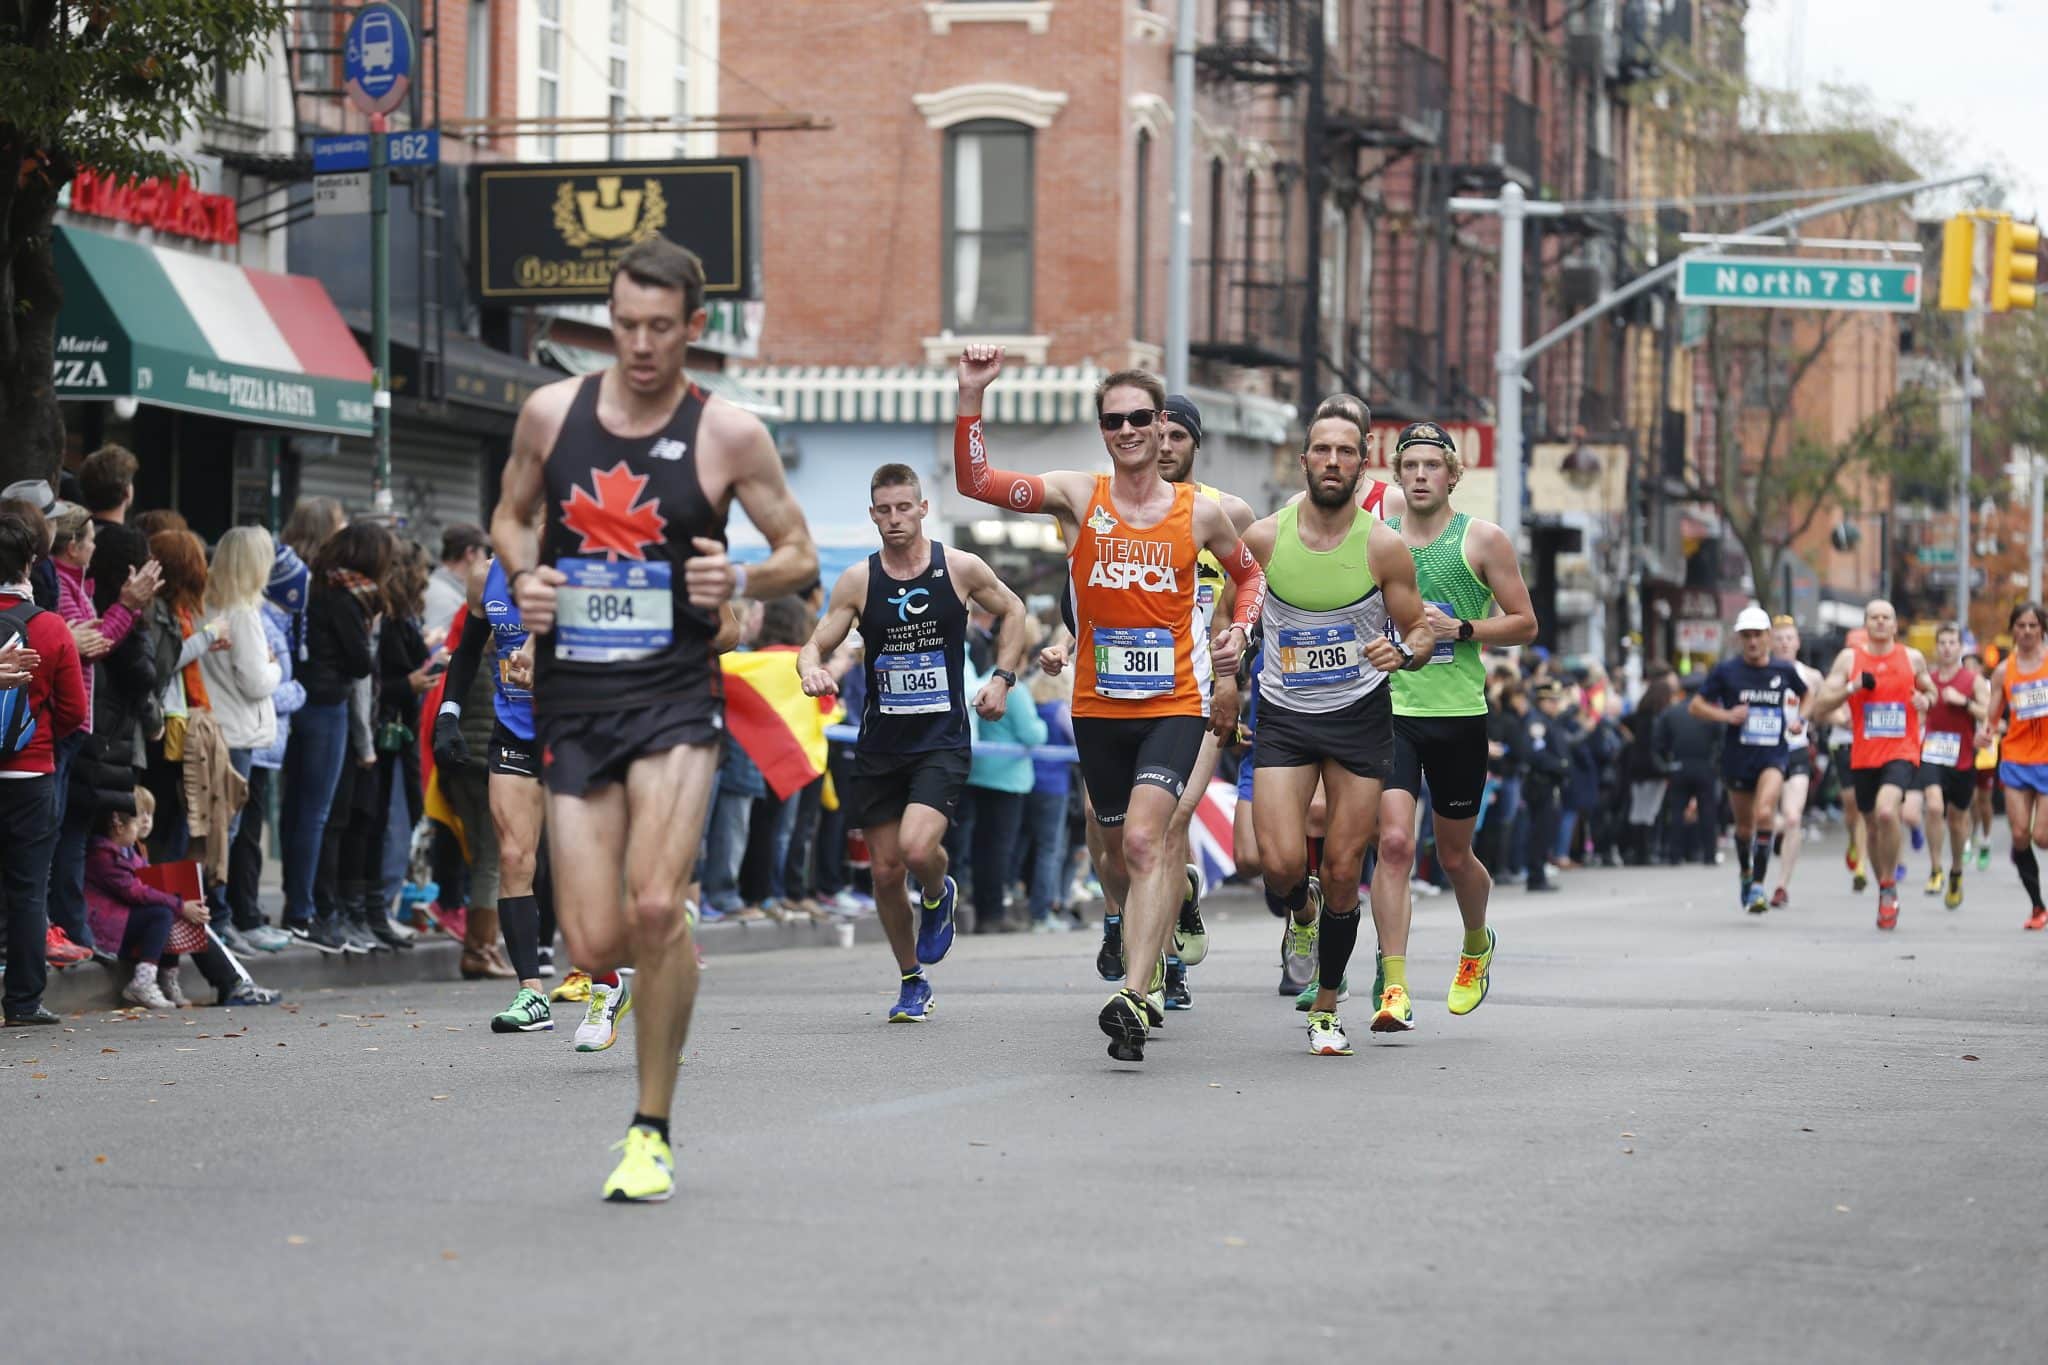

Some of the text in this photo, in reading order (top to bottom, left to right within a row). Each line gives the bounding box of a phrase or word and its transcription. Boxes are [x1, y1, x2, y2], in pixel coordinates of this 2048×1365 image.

[390, 135, 428, 161] B62
[1716, 268, 1882, 299] North 7 St
[57, 336, 108, 352] Maria
[229, 374, 265, 410] PIZZA
[277, 382, 316, 417] PASTA
[969, 419, 985, 464] ASPCA
[1095, 537, 1172, 568] TEAM
[1088, 561, 1179, 592] ASPCA
[588, 594, 635, 622] 884
[887, 620, 937, 634] TRAVERSE CITY
[888, 628, 936, 640] TRACK CLUB
[882, 636, 944, 652] Racing Team
[1124, 650, 1159, 672] 3811
[1307, 646, 1347, 670] 2136
[902, 671, 937, 691] 1345
